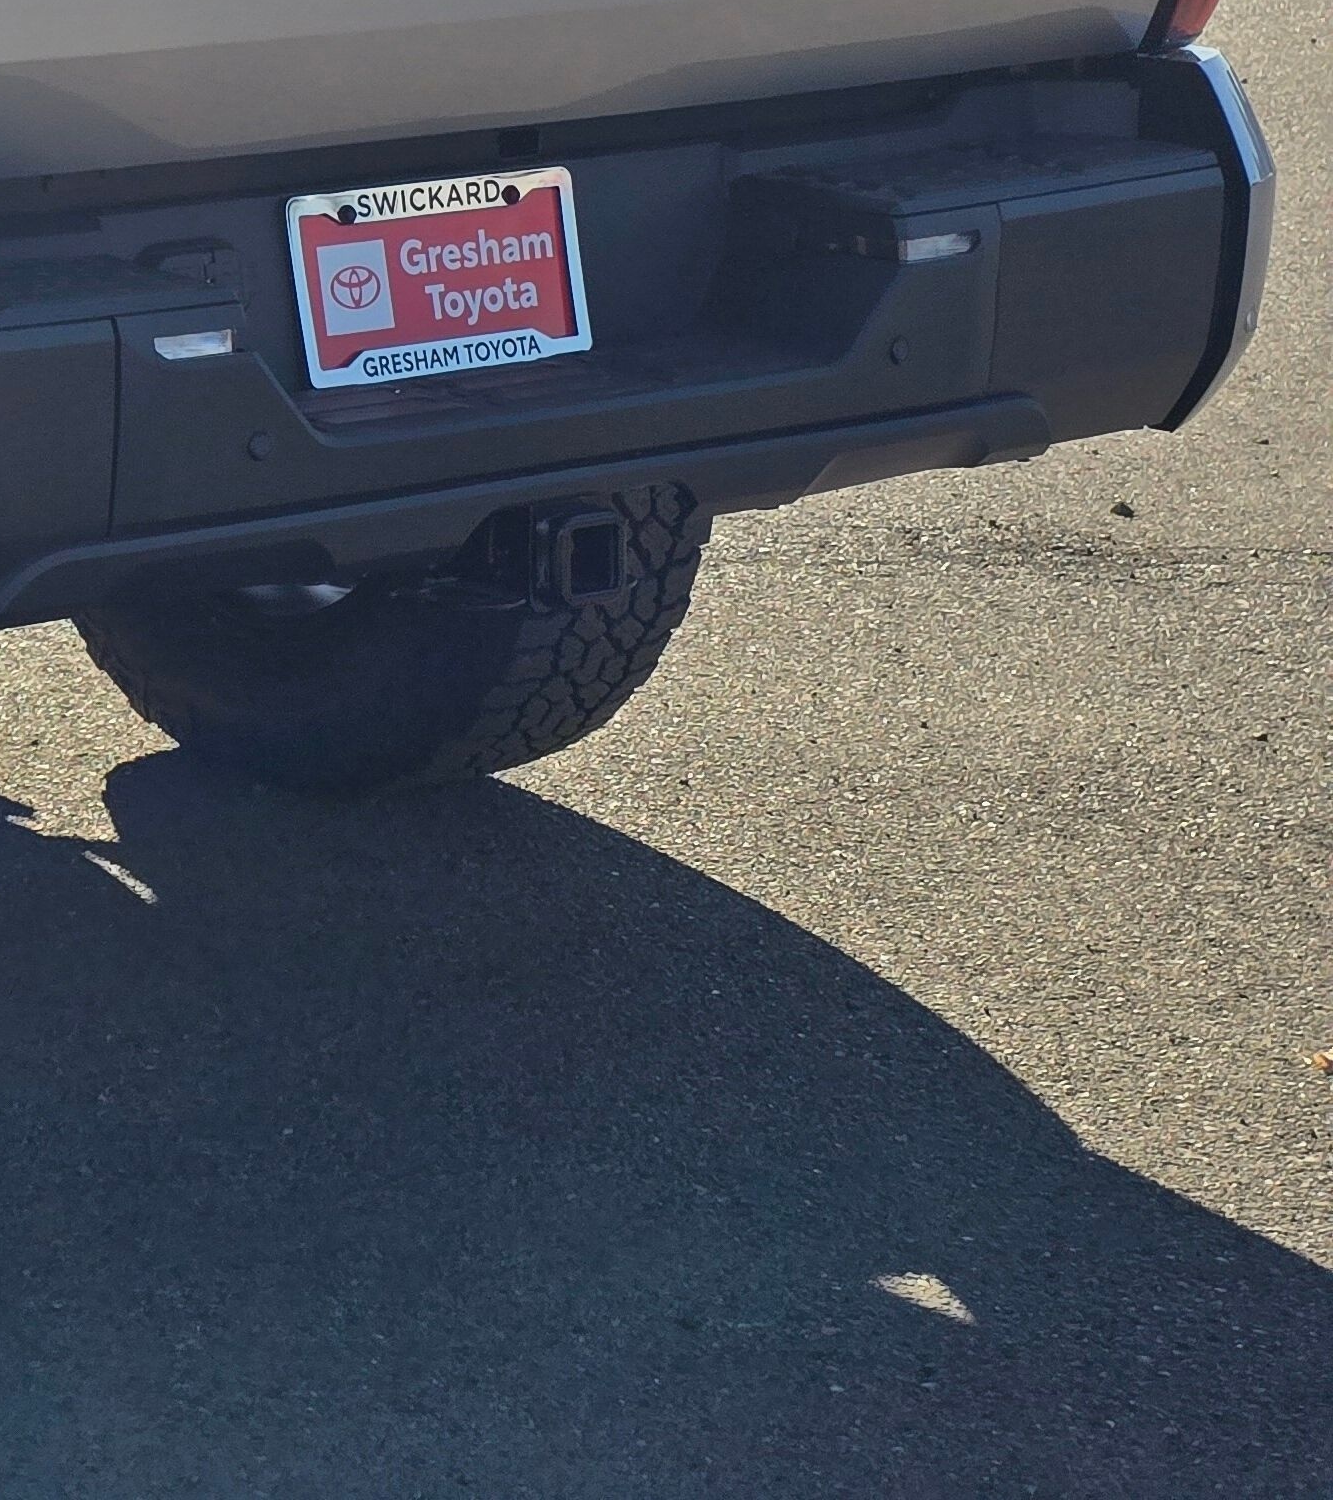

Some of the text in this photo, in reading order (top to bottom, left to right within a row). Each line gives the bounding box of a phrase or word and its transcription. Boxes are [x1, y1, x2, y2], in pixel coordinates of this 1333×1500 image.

[357, 179, 500, 218] SWICKARD
[399, 229, 554, 276] Gresham
[424, 277, 539, 326] Toyota
[362, 334, 542, 378] GRESHAM TOYOTA
